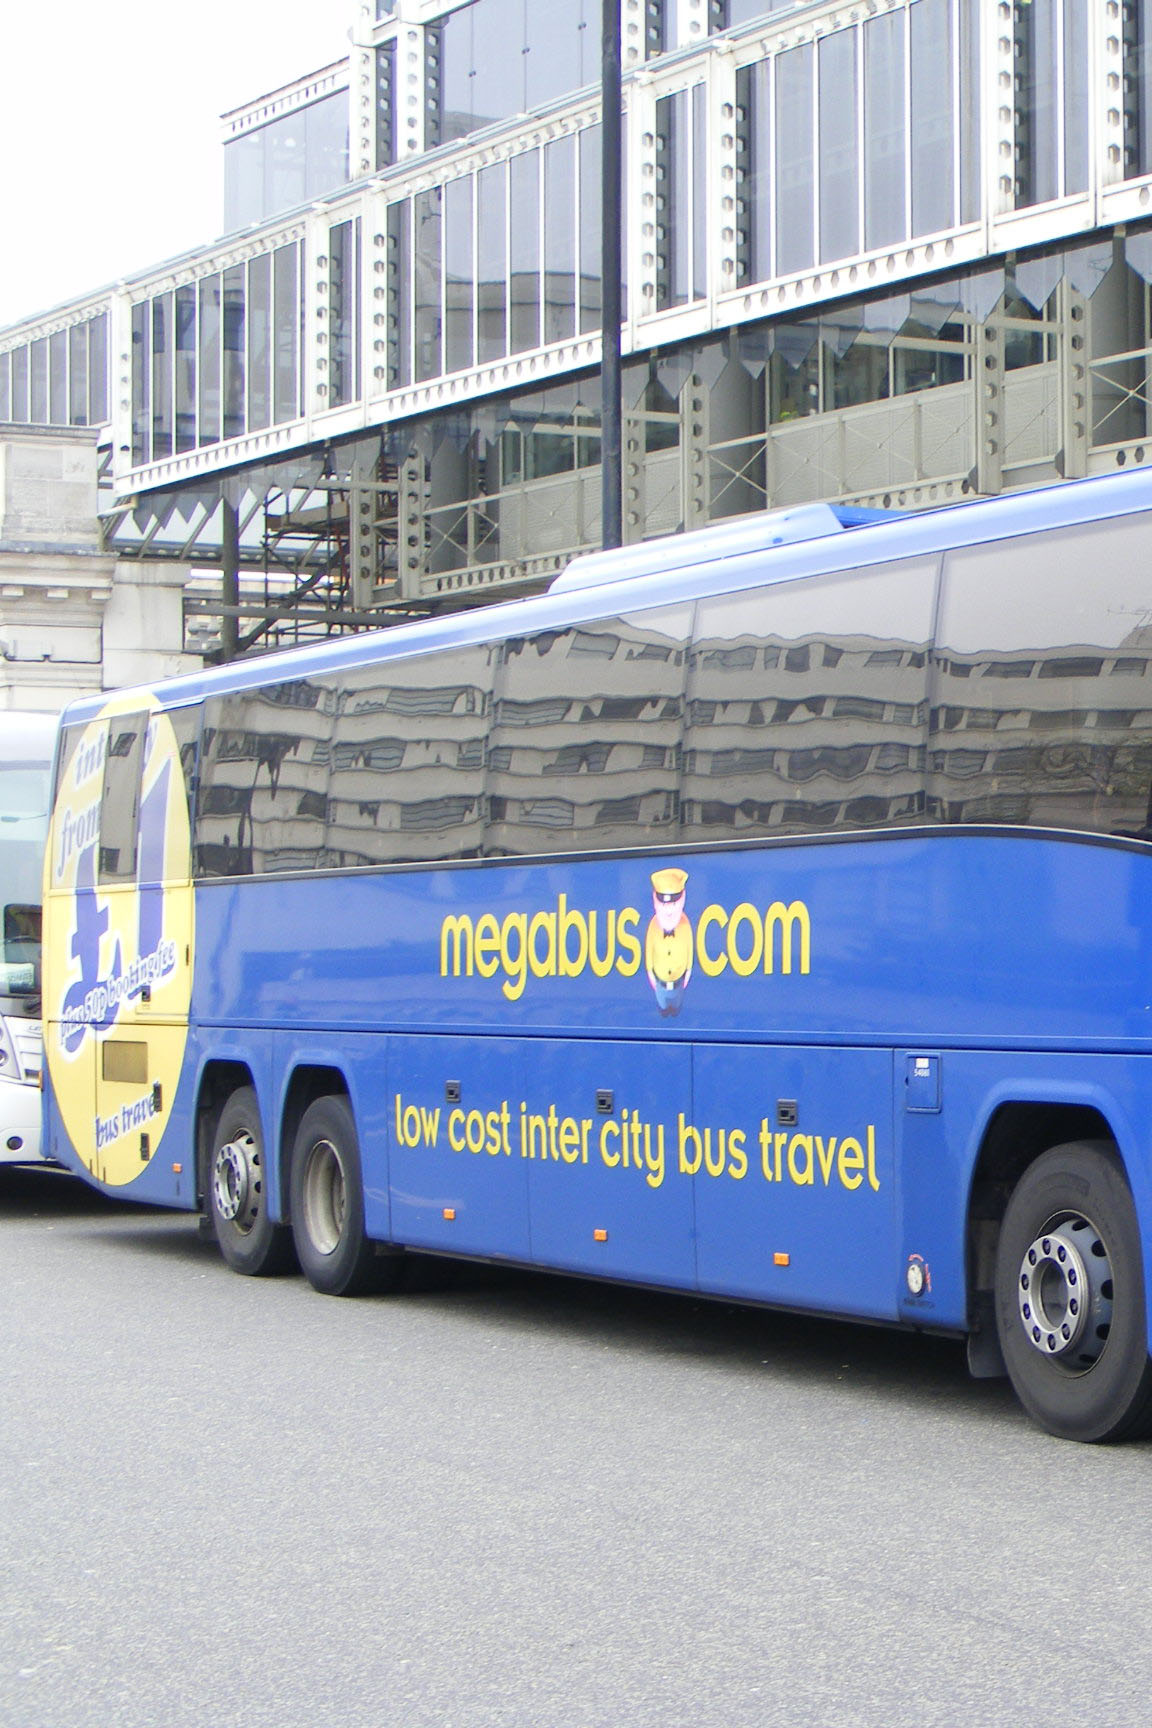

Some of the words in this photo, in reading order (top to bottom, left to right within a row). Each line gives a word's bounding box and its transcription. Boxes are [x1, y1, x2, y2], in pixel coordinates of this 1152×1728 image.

[439, 893, 642, 1001] megabus
[95, 1116, 119, 1147] bus
[395, 1093, 441, 1148] low
[448, 1100, 512, 1156] cost
[520, 1101, 593, 1164] inter
[600, 1108, 665, 1188] city
[678, 1112, 748, 1180] bus
[759, 1117, 881, 1192] travel
